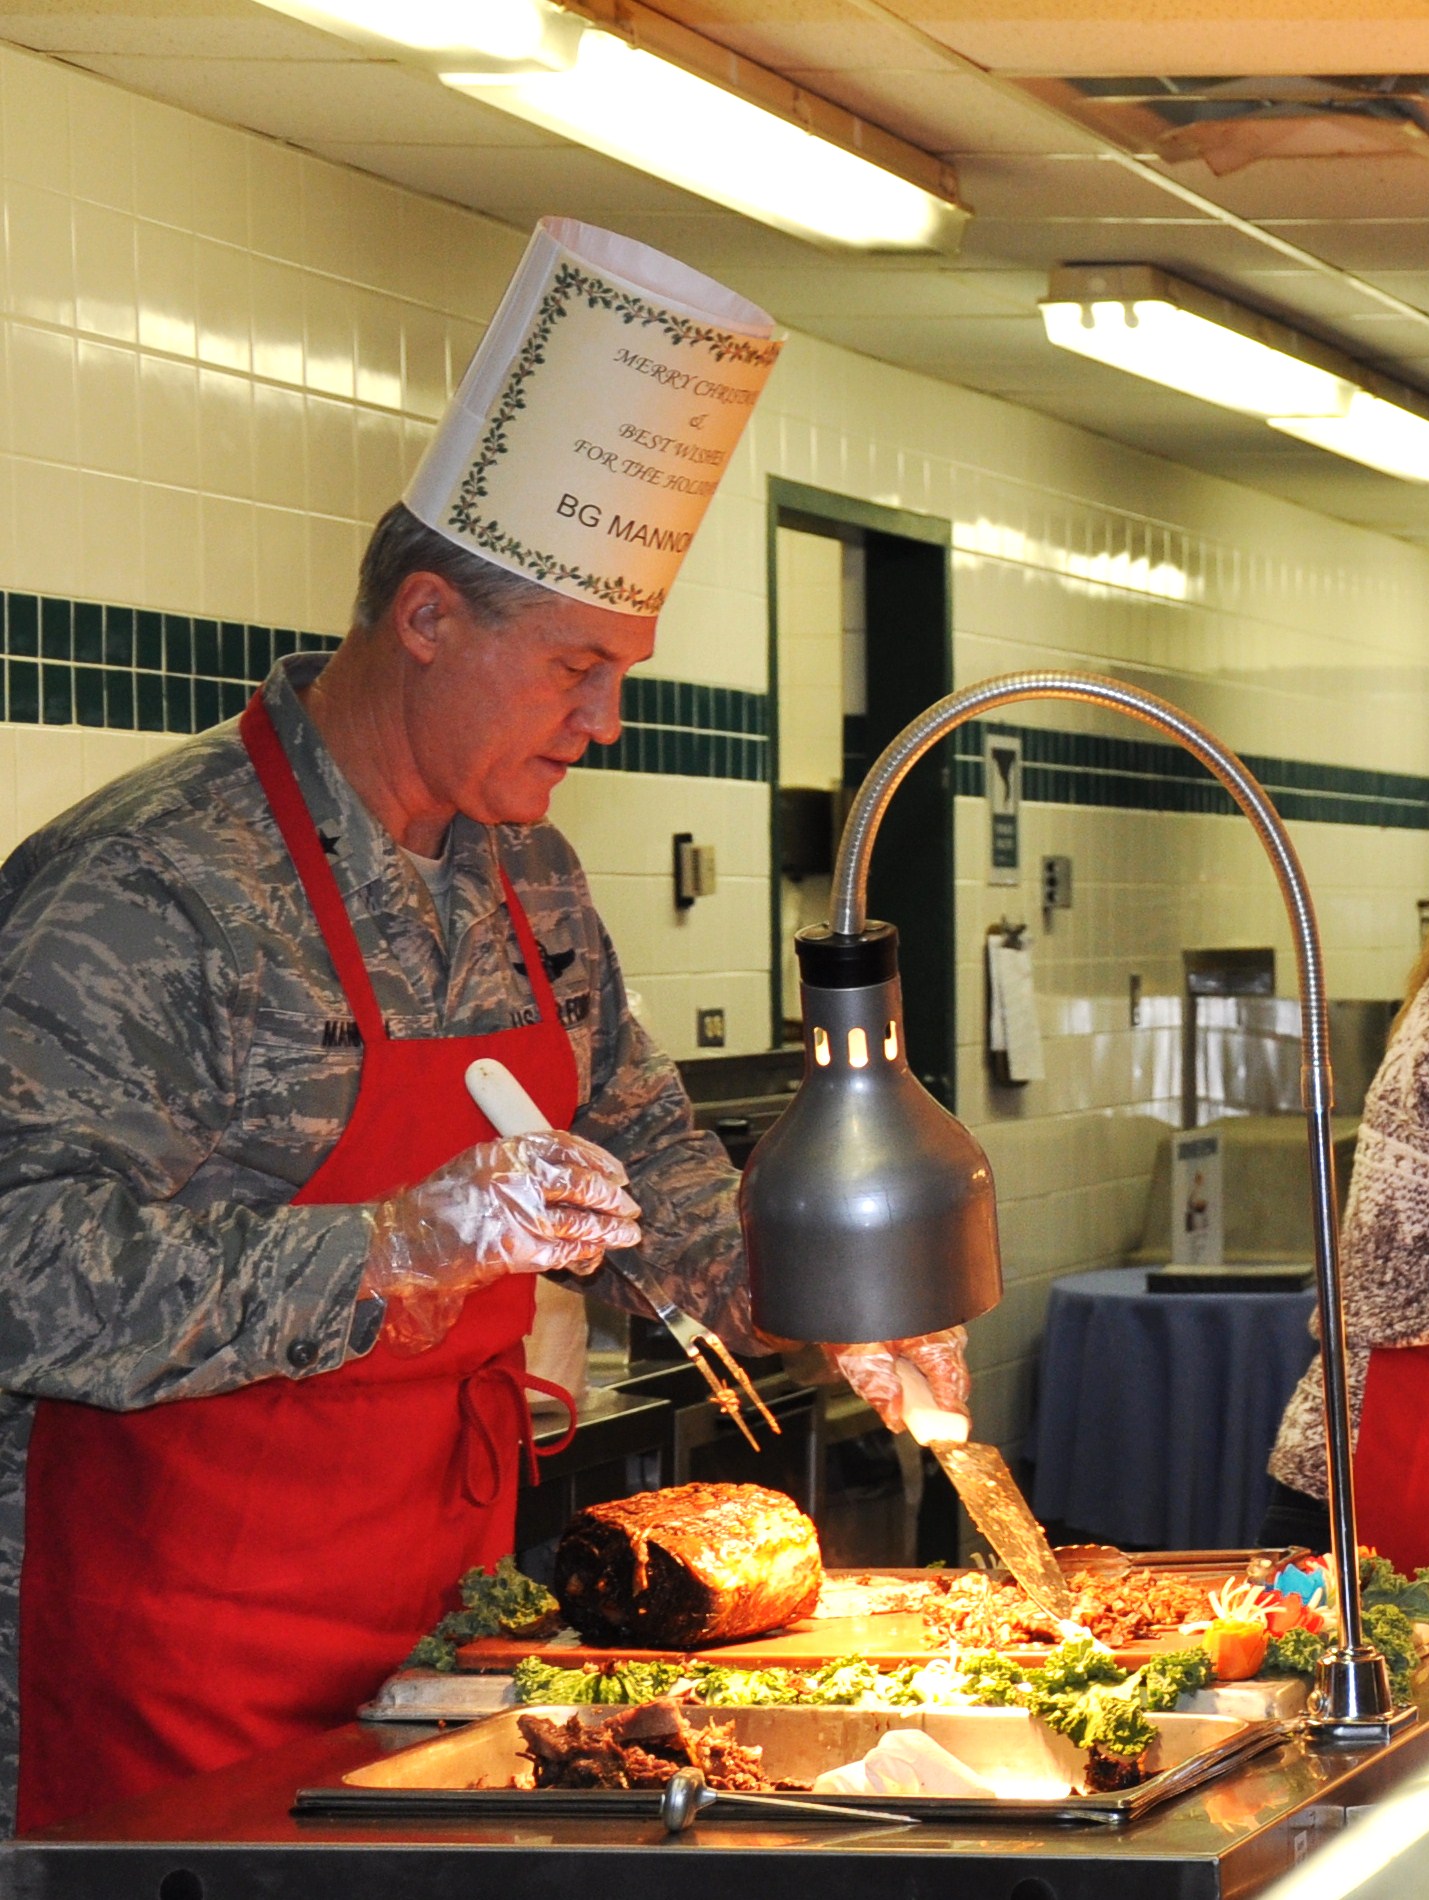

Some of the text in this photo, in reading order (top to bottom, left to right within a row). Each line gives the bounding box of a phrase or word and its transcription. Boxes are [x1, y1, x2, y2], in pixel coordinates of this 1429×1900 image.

[613, 348, 698, 390] MERRY
[618, 423, 675, 451] BEST
[573, 439, 618, 473] FOR
[621, 458, 665, 486] THE
[556, 493, 694, 553] BG MANNO
